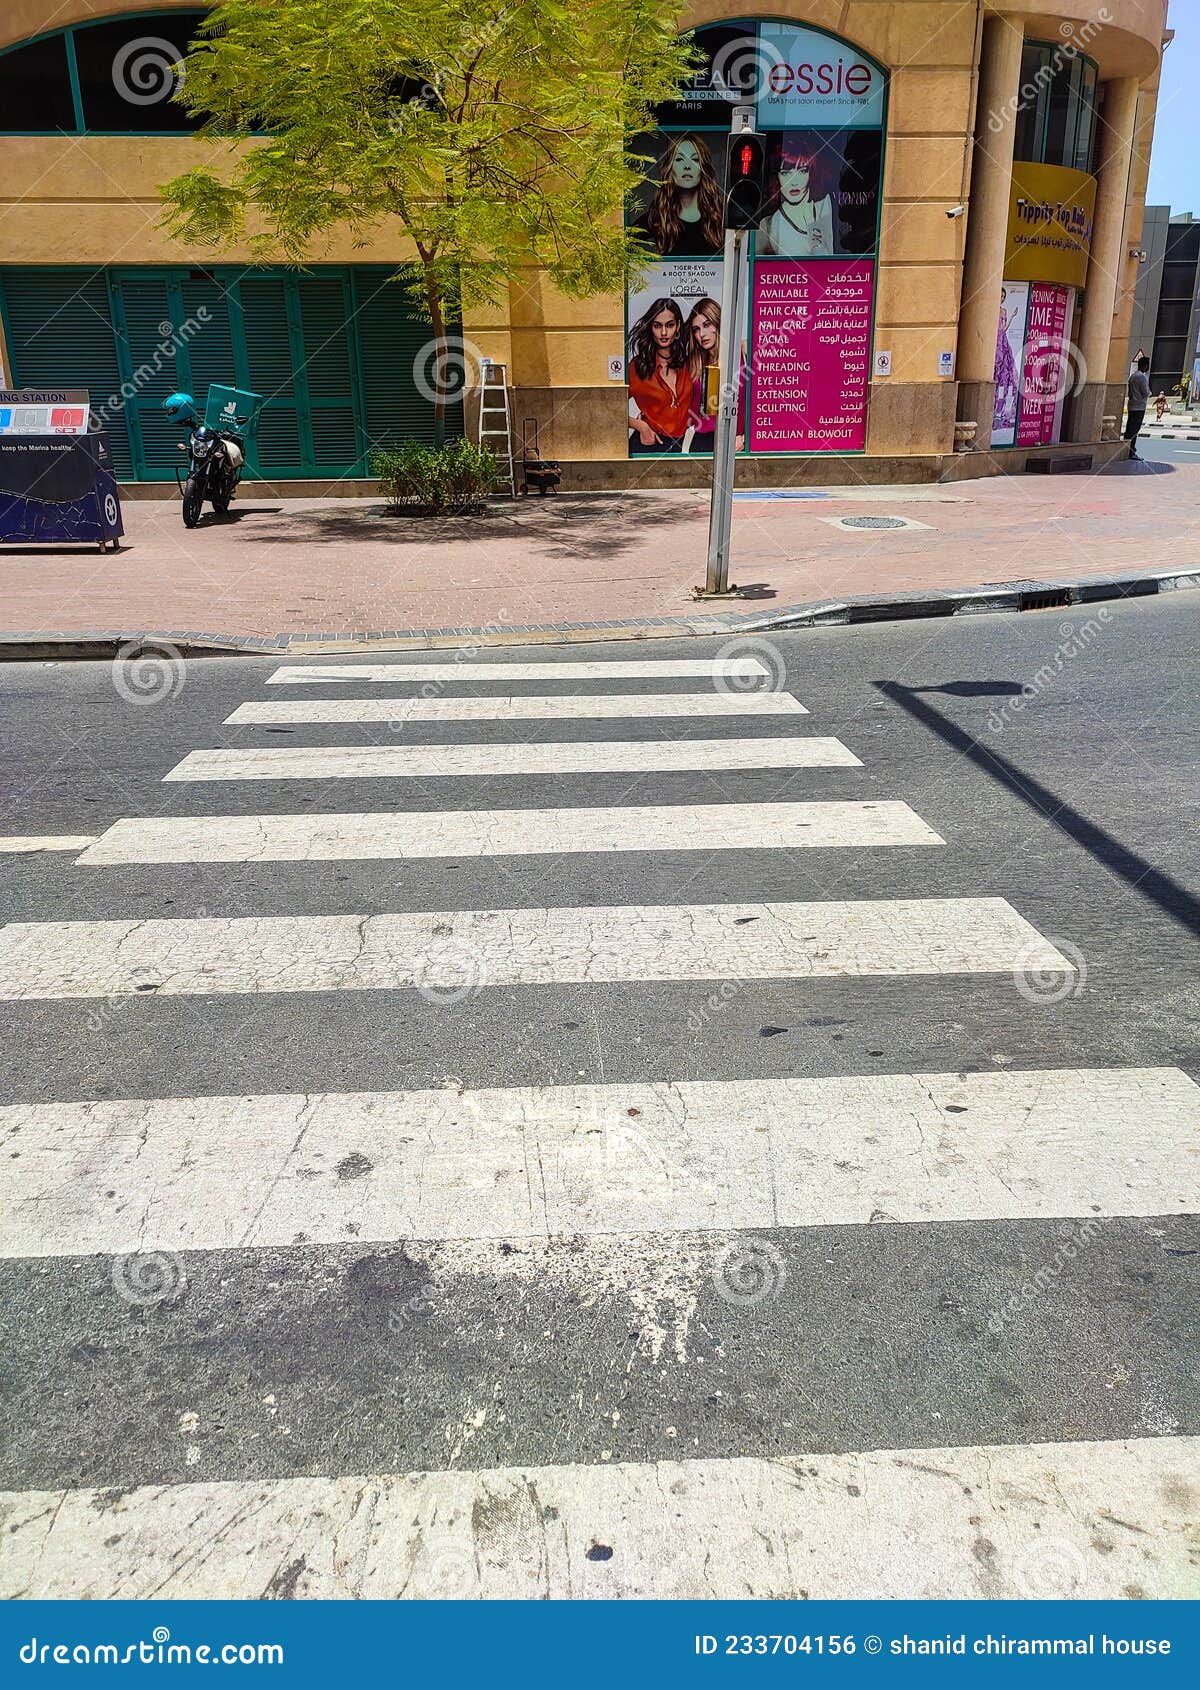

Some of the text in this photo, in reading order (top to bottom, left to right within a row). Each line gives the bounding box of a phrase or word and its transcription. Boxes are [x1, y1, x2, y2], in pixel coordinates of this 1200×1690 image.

[768, 58, 872, 95] essie
[1016, 199, 1054, 225] Tippity
[1057, 202, 1070, 227] Top
[760, 274, 808, 285] SERVICES
[827, 272, 870, 283] الخدمات
[759, 289, 809, 298] AVAILABLE
[825, 287, 863, 298] موجودة
[1032, 290, 1055, 304] PENING
[759, 306, 808, 316] HAIR CARE
[758, 320, 807, 330] NAIL CARE
[758, 335, 789, 344] FACIAL
[758, 349, 797, 358] WAXING
[757, 362, 811, 372] THREADING
[843, 361, 865, 372] خيوط
[757, 376, 799, 386] EYE LASH
[0, 393, 66, 402] ING STATION
[757, 389, 807, 399] EXTENSION
[756, 403, 806, 413] SCULPTING
[1023, 398, 1043, 415] WEEK
[756, 417, 773, 426] GEL
[756, 429, 853, 439] BRAZILIAN BLOWOUT
